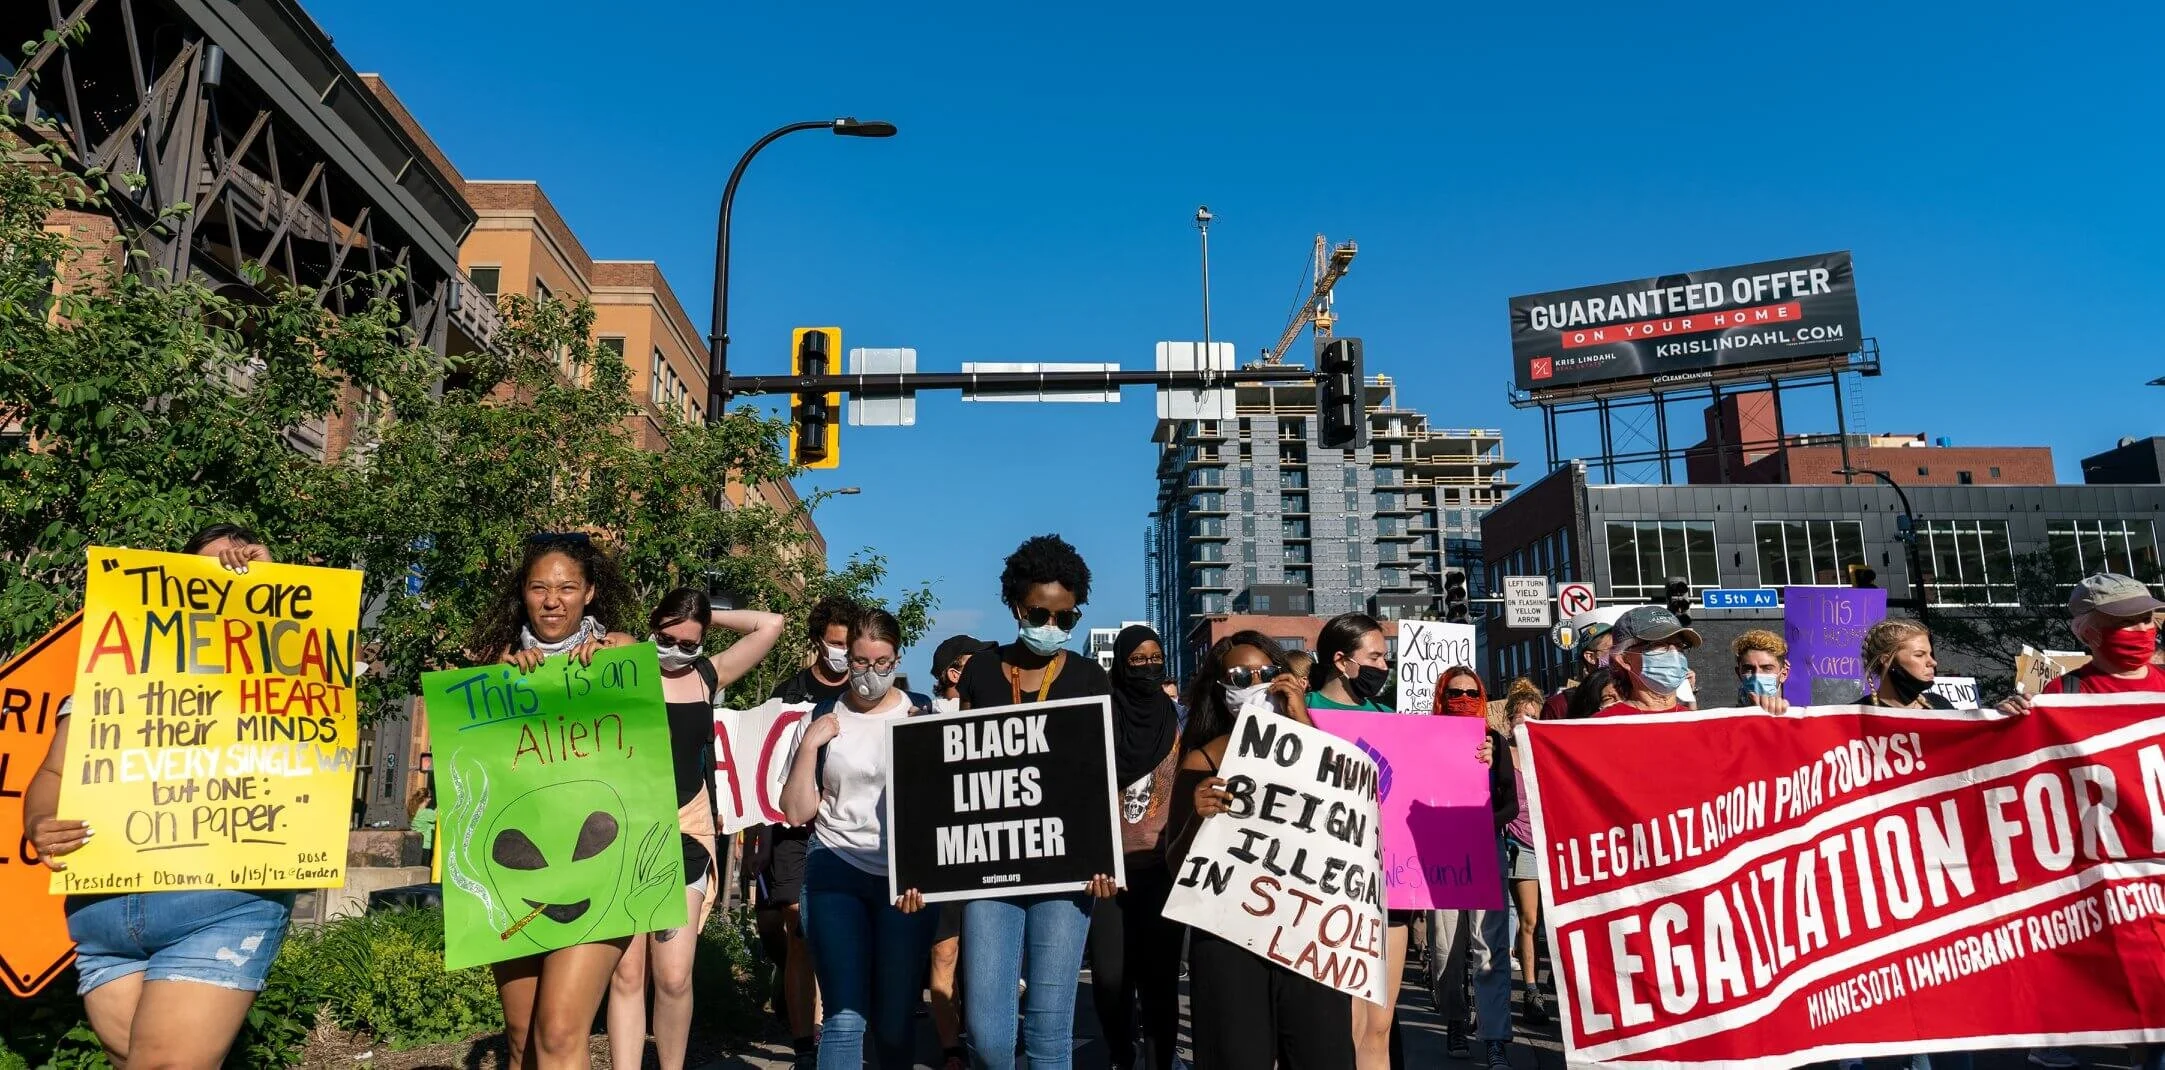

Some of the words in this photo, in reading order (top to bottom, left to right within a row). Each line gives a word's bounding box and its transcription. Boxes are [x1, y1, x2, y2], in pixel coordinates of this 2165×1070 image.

[1530, 281, 1724, 332] GUARANTEED
[1732, 267, 1832, 304] OFFER
[1574, 331, 1605, 344] ON
[1624, 319, 1693, 337] YOUR
[1714, 306, 1788, 324] HOME
[1656, 324, 1844, 358] KRISLINDAHL.COM
[1578, 353, 1617, 364] LINDAHL
[246, 583, 313, 619] are
[1710, 594, 1718, 604] S
[1725, 594, 1748, 604] 5th
[1755, 594, 1771, 604] Av
[84, 610, 355, 688] AMERICAN
[1402, 623, 1473, 668] Xicana
[446, 670, 539, 720] This
[563, 666, 592, 700] is
[601, 659, 637, 689] an
[1401, 662, 1422, 684] on
[94, 681, 125, 716] in
[138, 680, 222, 716] their
[90, 719, 121, 749] in
[137, 719, 218, 747] their
[943, 714, 1050, 763] BLACK
[81, 754, 114, 785] in
[120, 747, 221, 783] EVERY
[224, 742, 313, 777] SINGLE
[1238, 714, 1303, 768] NO
[1316, 746, 1380, 803] HUMA
[1773, 763, 1824, 822] PARA
[1823, 732, 1927, 798] TODXS!
[153, 778, 200, 805] but
[953, 766, 1043, 813] LIVES
[1225, 774, 1366, 848] BEIGN
[936, 817, 1065, 866] MATTER
[296, 867, 339, 880] Garden
[982, 873, 1021, 884] surjmn.org
[1177, 856, 1235, 896] IN
[1567, 797, 1976, 1036] LEGALIZATION
[1983, 764, 2128, 884] FOR
[1806, 962, 1905, 1030] MINNESOTA
[1906, 920, 2025, 992] IMMIGRANT
[2028, 896, 2103, 954] RIGHTS
